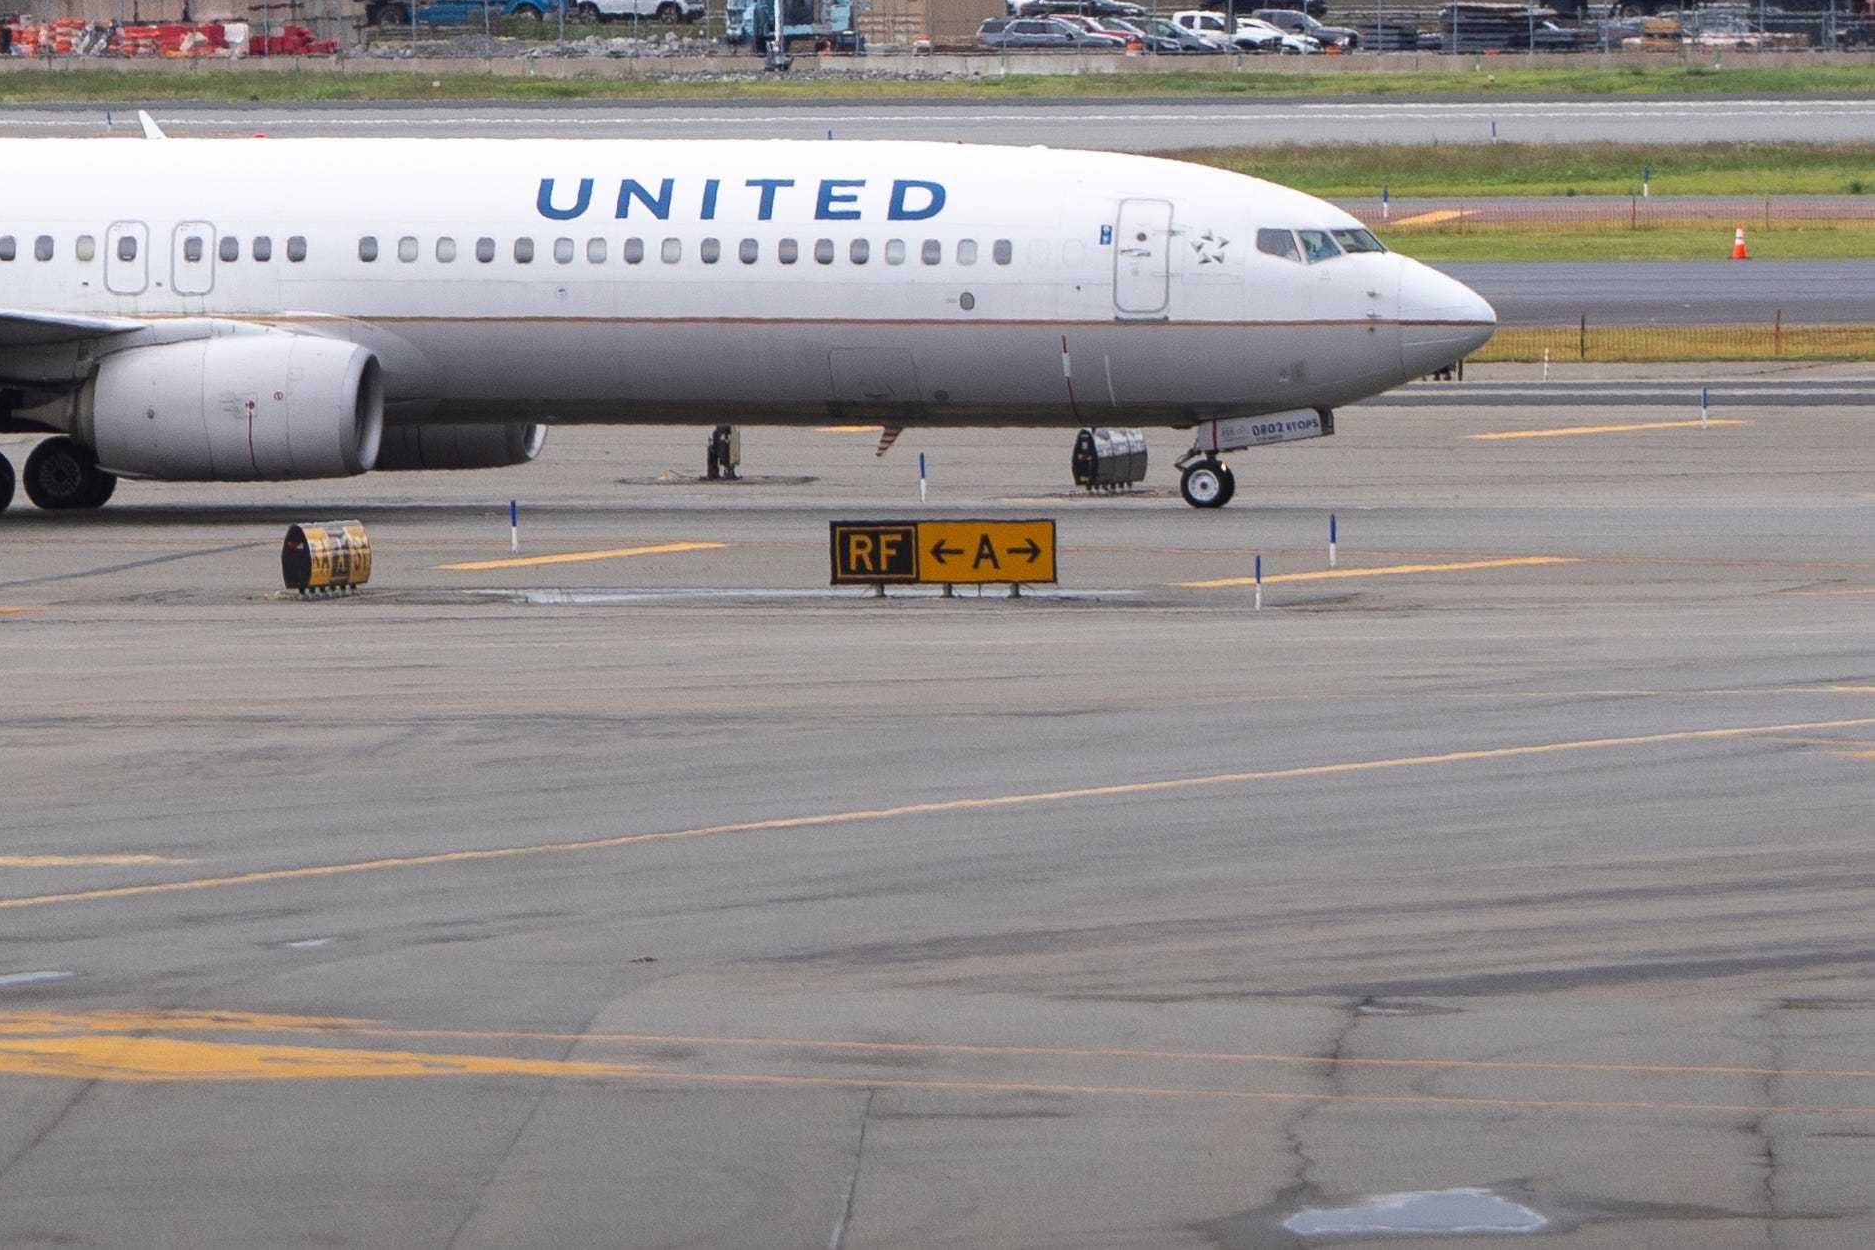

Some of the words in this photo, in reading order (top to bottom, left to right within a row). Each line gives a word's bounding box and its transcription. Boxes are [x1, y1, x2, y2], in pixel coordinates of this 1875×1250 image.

[536, 178, 947, 221] UNITED
[1252, 422, 1284, 436] 0802
[1286, 418, 1319, 432] ETOPS
[849, 534, 902, 571] RF
[972, 533, 1000, 569] A
